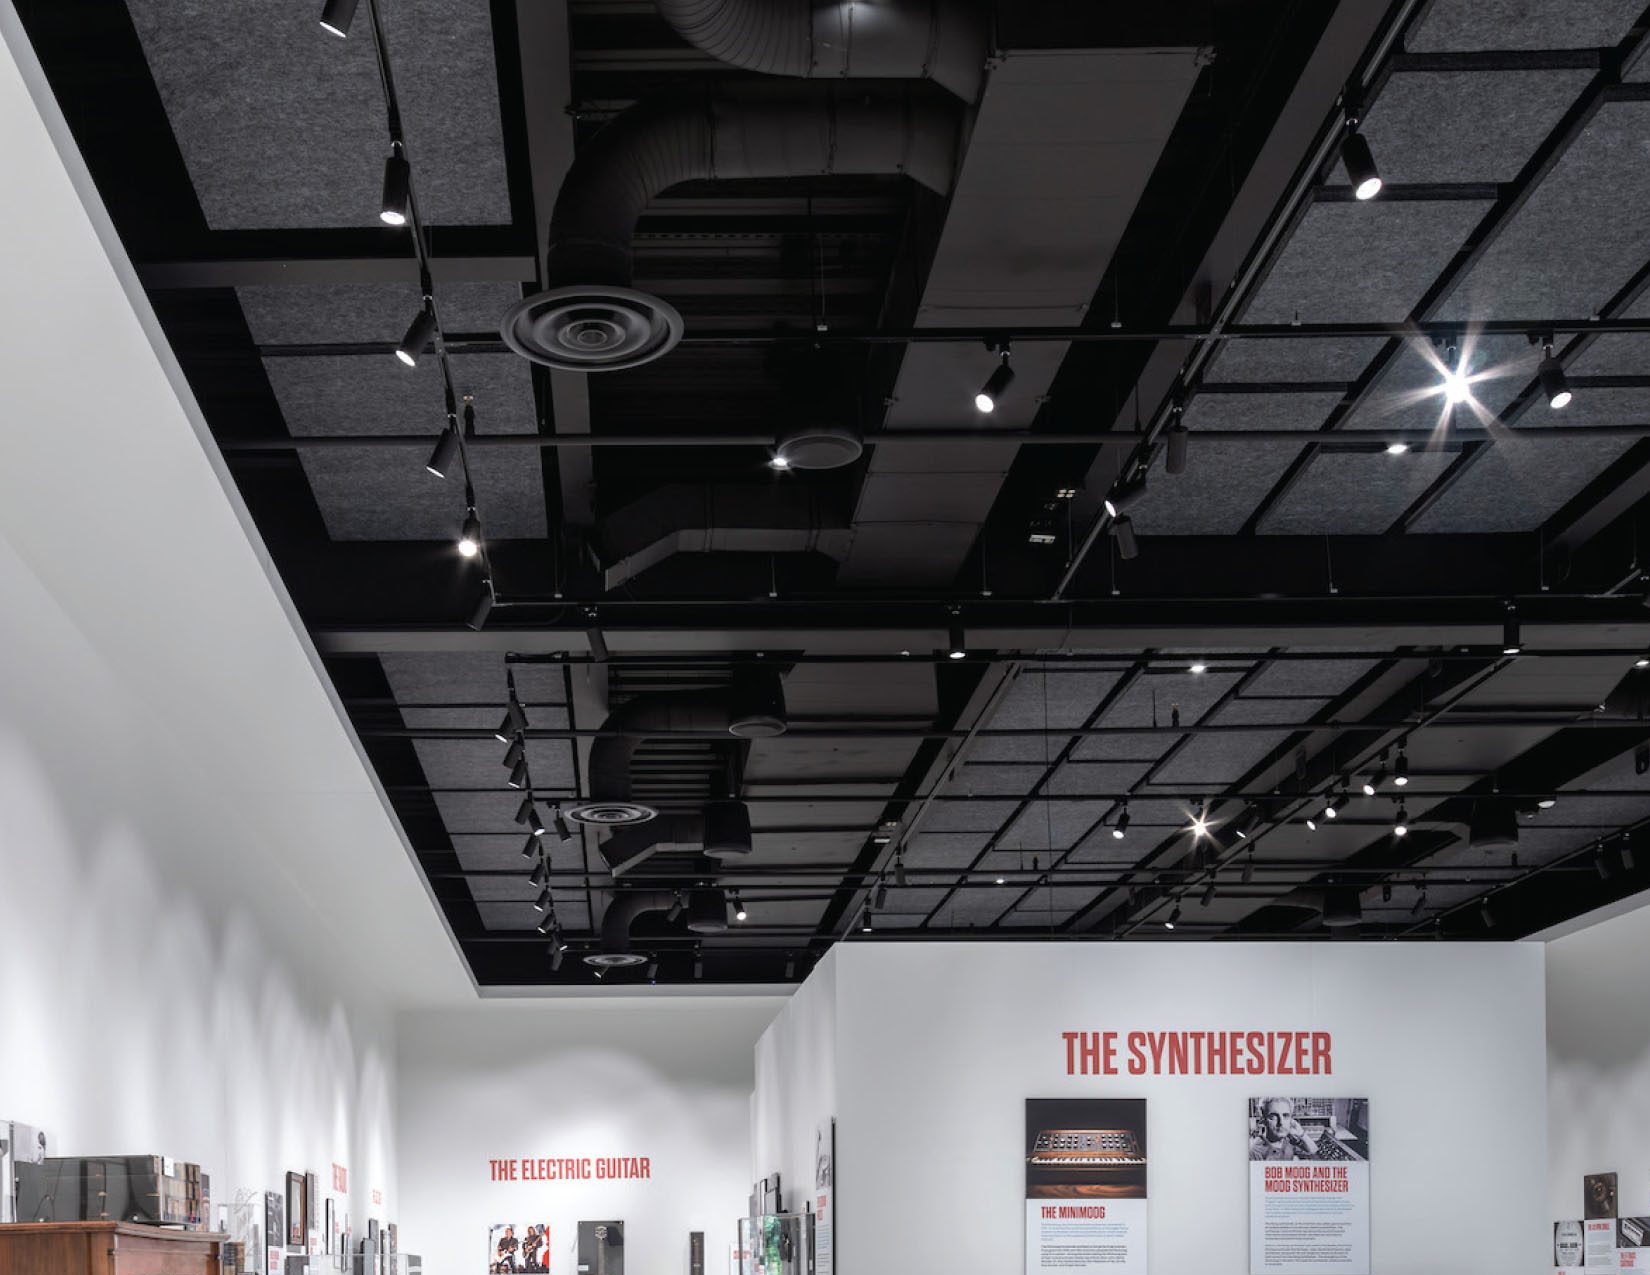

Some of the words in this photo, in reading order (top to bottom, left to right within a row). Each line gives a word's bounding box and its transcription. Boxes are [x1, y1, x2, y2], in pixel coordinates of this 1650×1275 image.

[1062, 1032, 1118, 1075] THE
[1128, 1031, 1332, 1075] SYNTHESIZER
[489, 1159, 518, 1181] THE
[522, 1158, 592, 1180] ELECTRIC
[596, 1157, 650, 1180] GUITAR
[1265, 1166, 1283, 1179] BOB
[1285, 1166, 1311, 1179] MOOG
[1312, 1166, 1331, 1179] AND
[1333, 1166, 1348, 1179] THE
[1265, 1180, 1291, 1193] MOOG
[1293, 1180, 1349, 1193] SYNTHESIZER
[1041, 1206, 1056, 1219] THE
[1059, 1206, 1105, 1219] MINIMOOG
